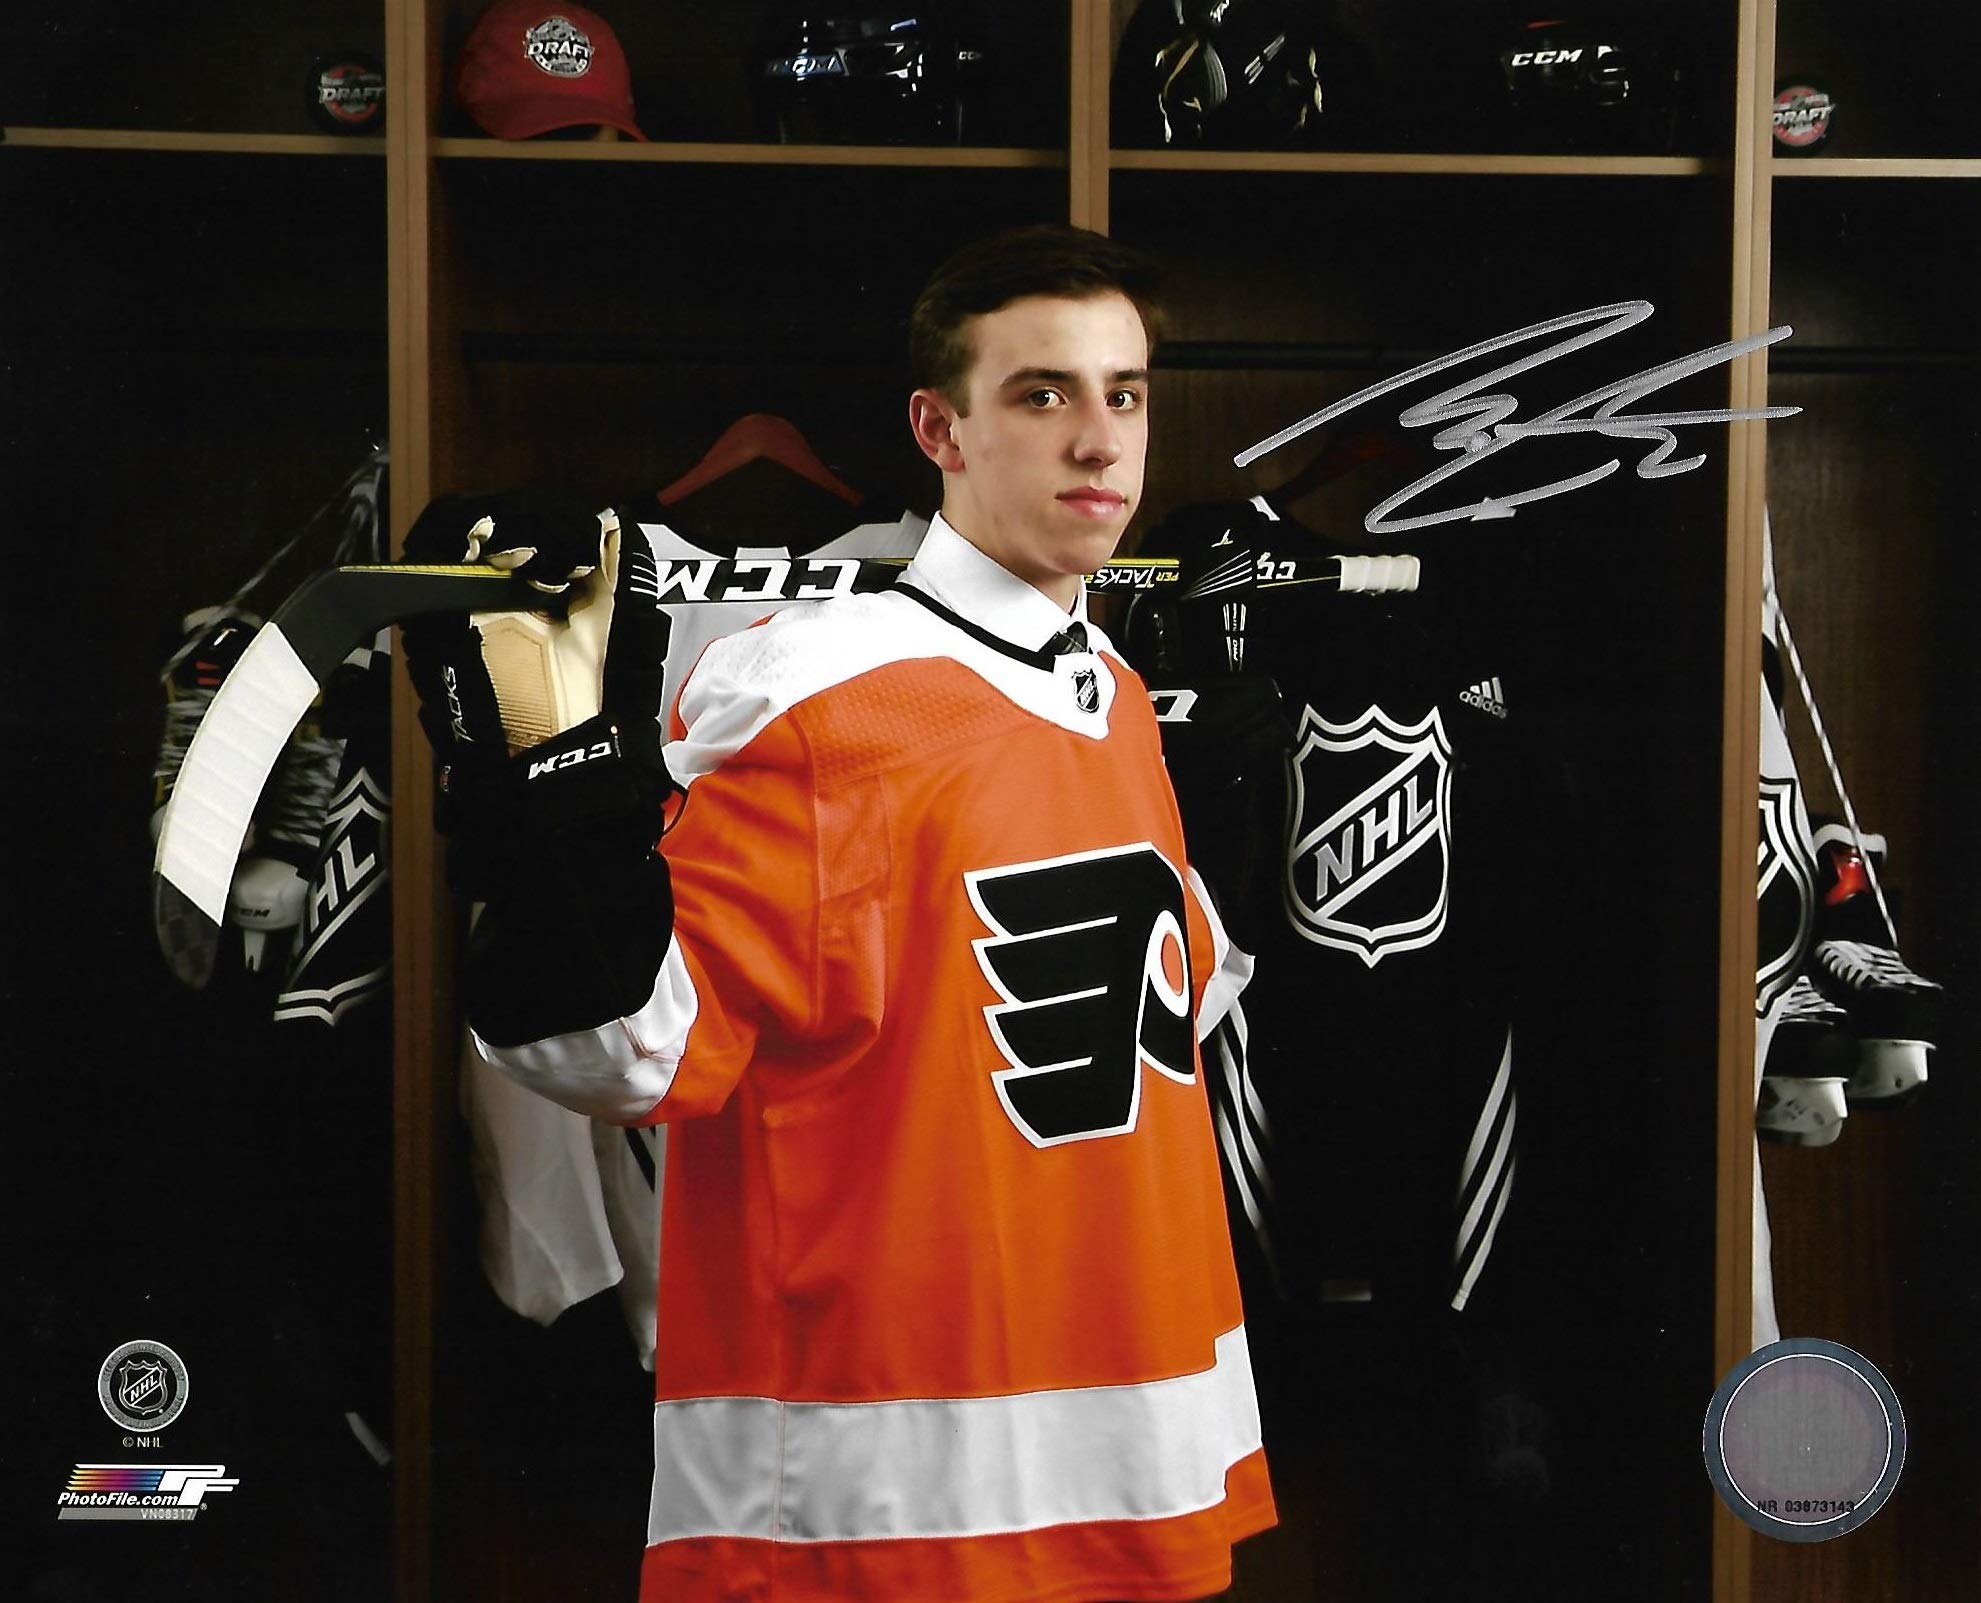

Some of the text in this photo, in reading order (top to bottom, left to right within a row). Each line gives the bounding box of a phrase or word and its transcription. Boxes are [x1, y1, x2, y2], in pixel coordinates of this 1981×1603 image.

[528, 41, 590, 58] DRAFT
[1511, 49, 1583, 67] CCM
[321, 87, 384, 101] DRAFT
[1773, 107, 1832, 125] DRAFT
[657, 559, 861, 601] CCM
[1094, 565, 1155, 588] TACKS
[1155, 571, 1180, 582] PER
[1256, 561, 1297, 580] CC
[442, 665, 475, 742] TACKS
[1459, 690, 1508, 719] adidas
[528, 741, 613, 780] CCM
[1314, 774, 1433, 902] NHL
[309, 835, 376, 933] HL
[1757, 1500, 1778, 1513] NR
